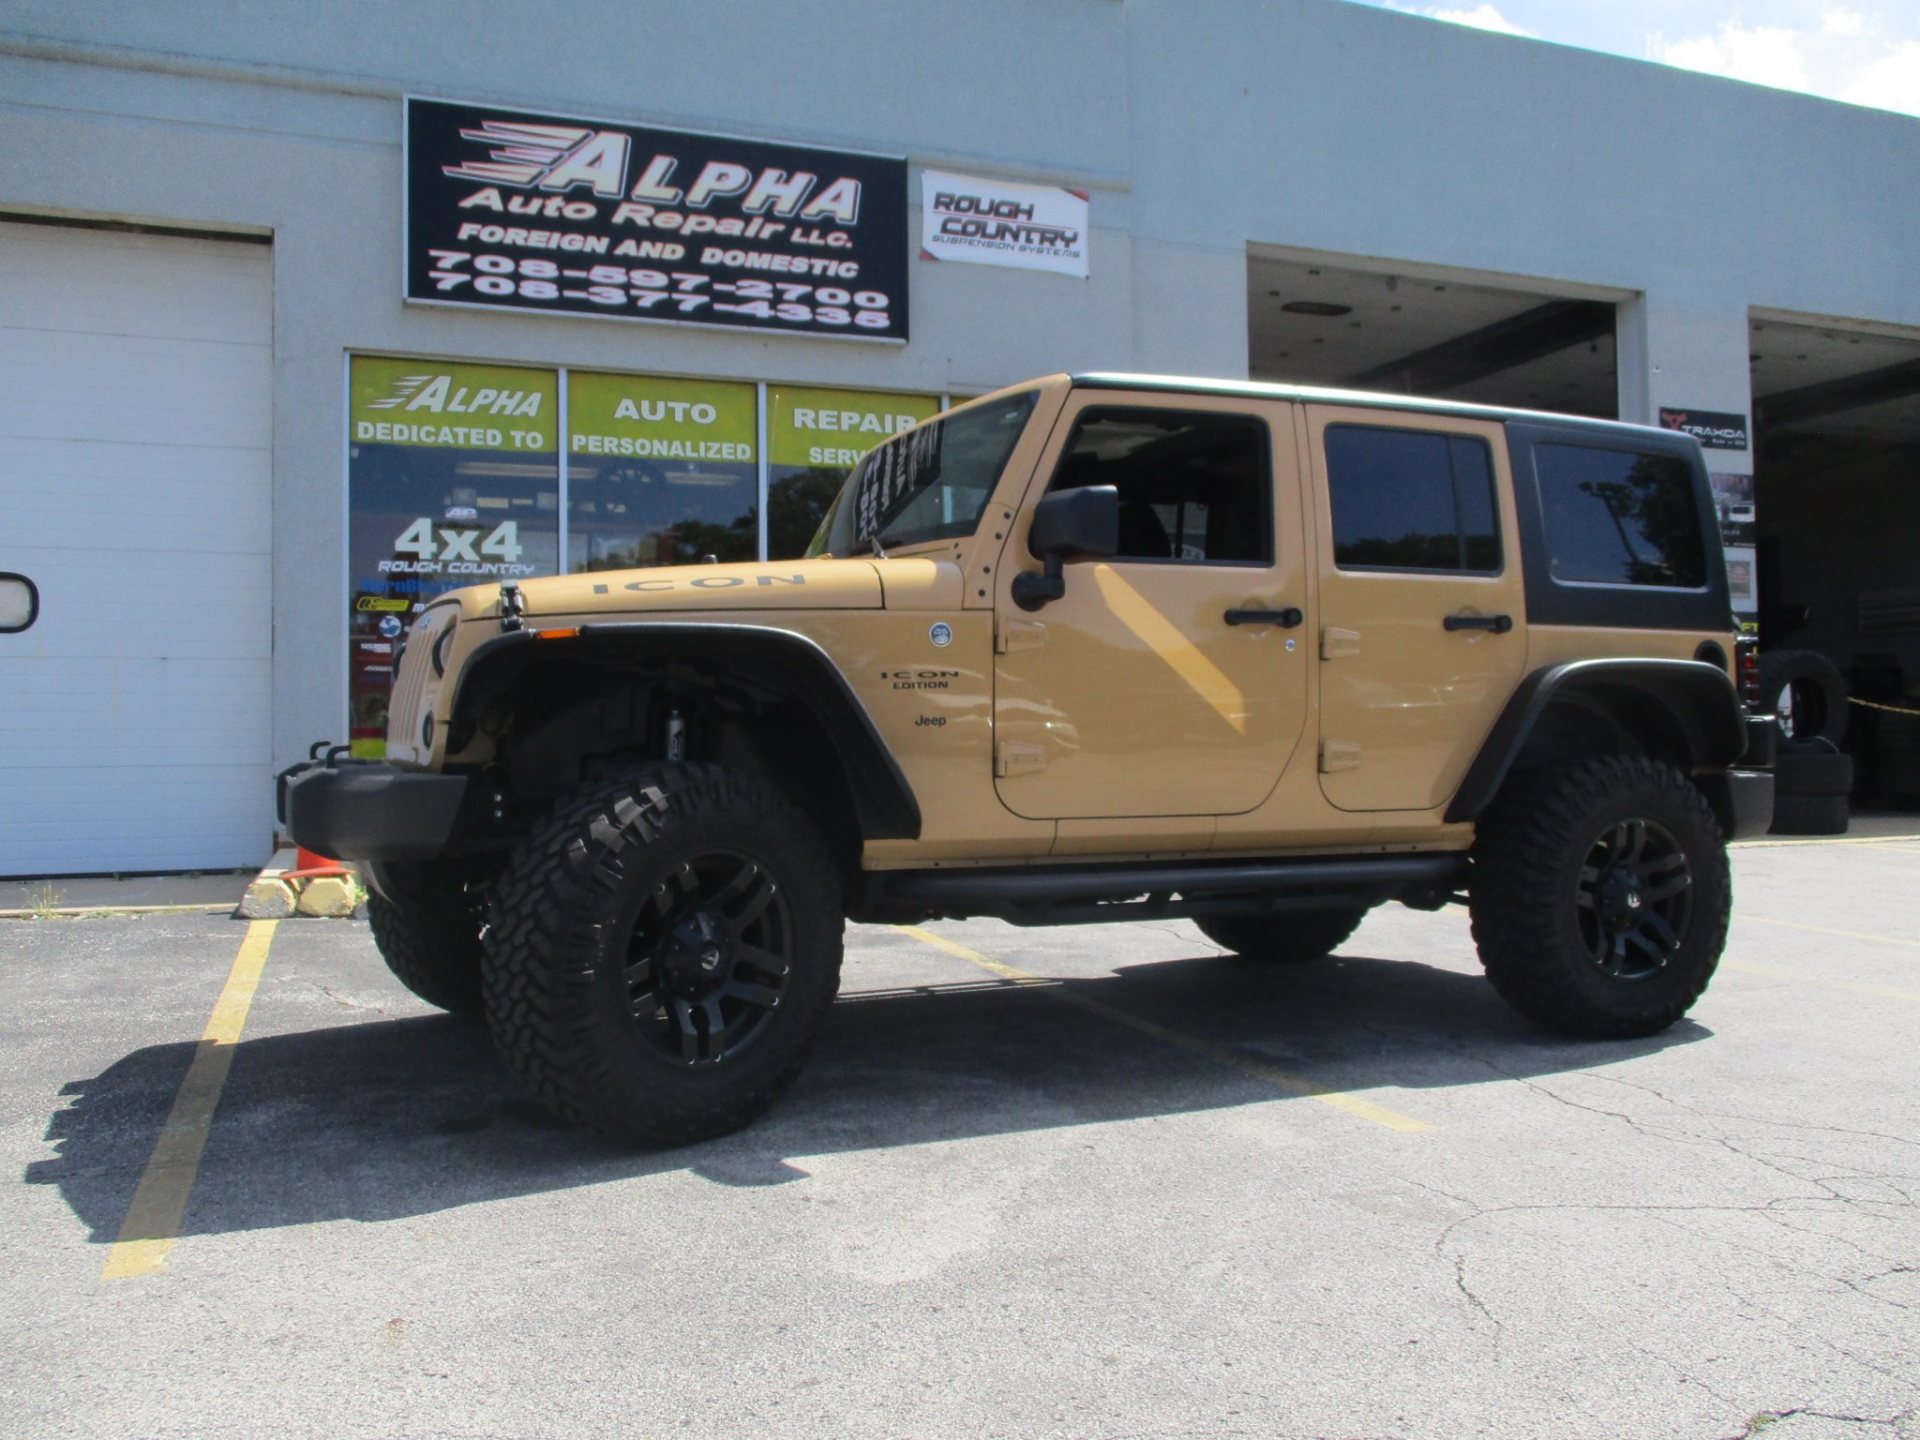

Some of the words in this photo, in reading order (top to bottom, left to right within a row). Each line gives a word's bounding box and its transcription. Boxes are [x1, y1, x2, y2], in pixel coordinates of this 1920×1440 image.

[539, 129, 861, 225] ALPHA
[459, 187, 598, 220] Auto
[611, 203, 787, 239] Repair
[790, 227, 854, 249] LLC.
[933, 192, 1034, 221] ROUGH
[931, 234, 1015, 251] SUSPENSION
[1018, 245, 1080, 258] SYSTEMS
[940, 217, 1078, 248] COUNTRY
[457, 222, 609, 255] FOREIGN
[613, 238, 685, 262] AND
[701, 247, 860, 280] DOMESTIC
[428, 249, 890, 309] 708-597-2700
[404, 375, 542, 417] ALPHA
[614, 397, 717, 425] AUTO
[793, 407, 918, 435] REPAIR
[357, 421, 503, 445] DEDICATED
[510, 431, 543, 449] TO
[572, 434, 752, 461] PERSONALIZED
[394, 517, 523, 562] 4x4
[378, 561, 442, 573] ROUGH
[448, 562, 535, 576] COUNTRY
[592, 574, 806, 595] ICON
[881, 670, 959, 679] ICON
[892, 681, 948, 690] EDITION
[915, 714, 947, 727] Jeep
